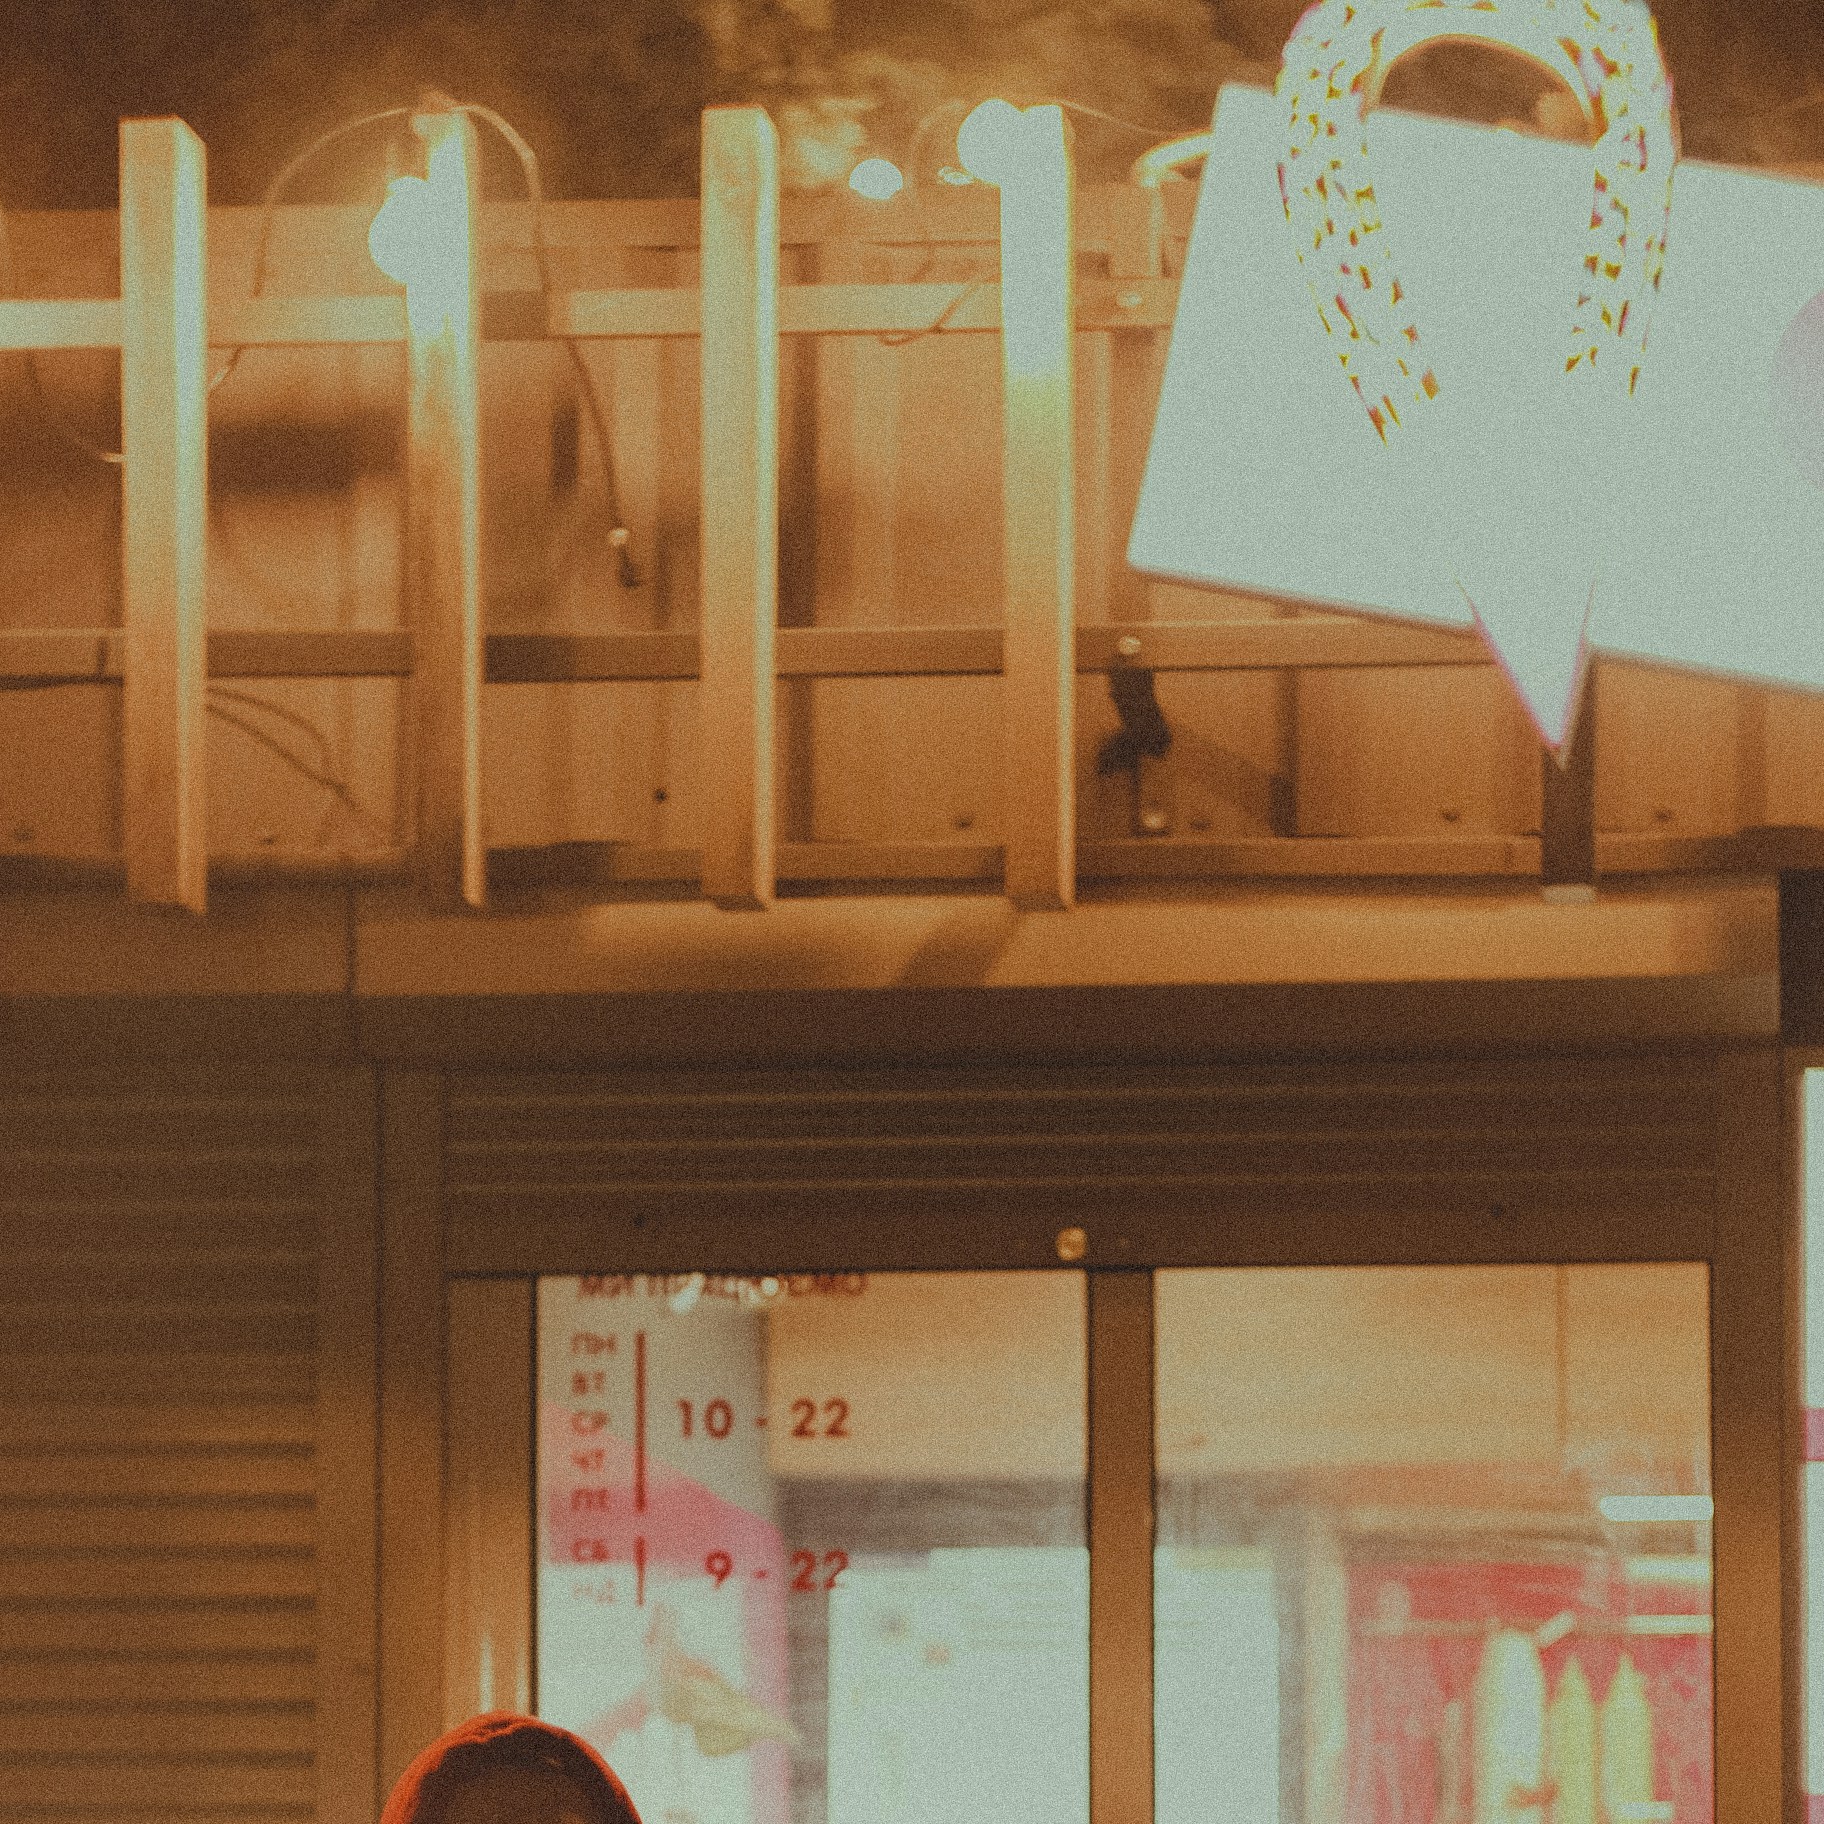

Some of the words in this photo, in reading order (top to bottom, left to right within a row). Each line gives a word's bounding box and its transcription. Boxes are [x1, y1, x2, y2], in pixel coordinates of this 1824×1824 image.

[677, 1398, 734, 1440] 10
[789, 1398, 852, 1440] 22
[704, 1549, 734, 1589] 9
